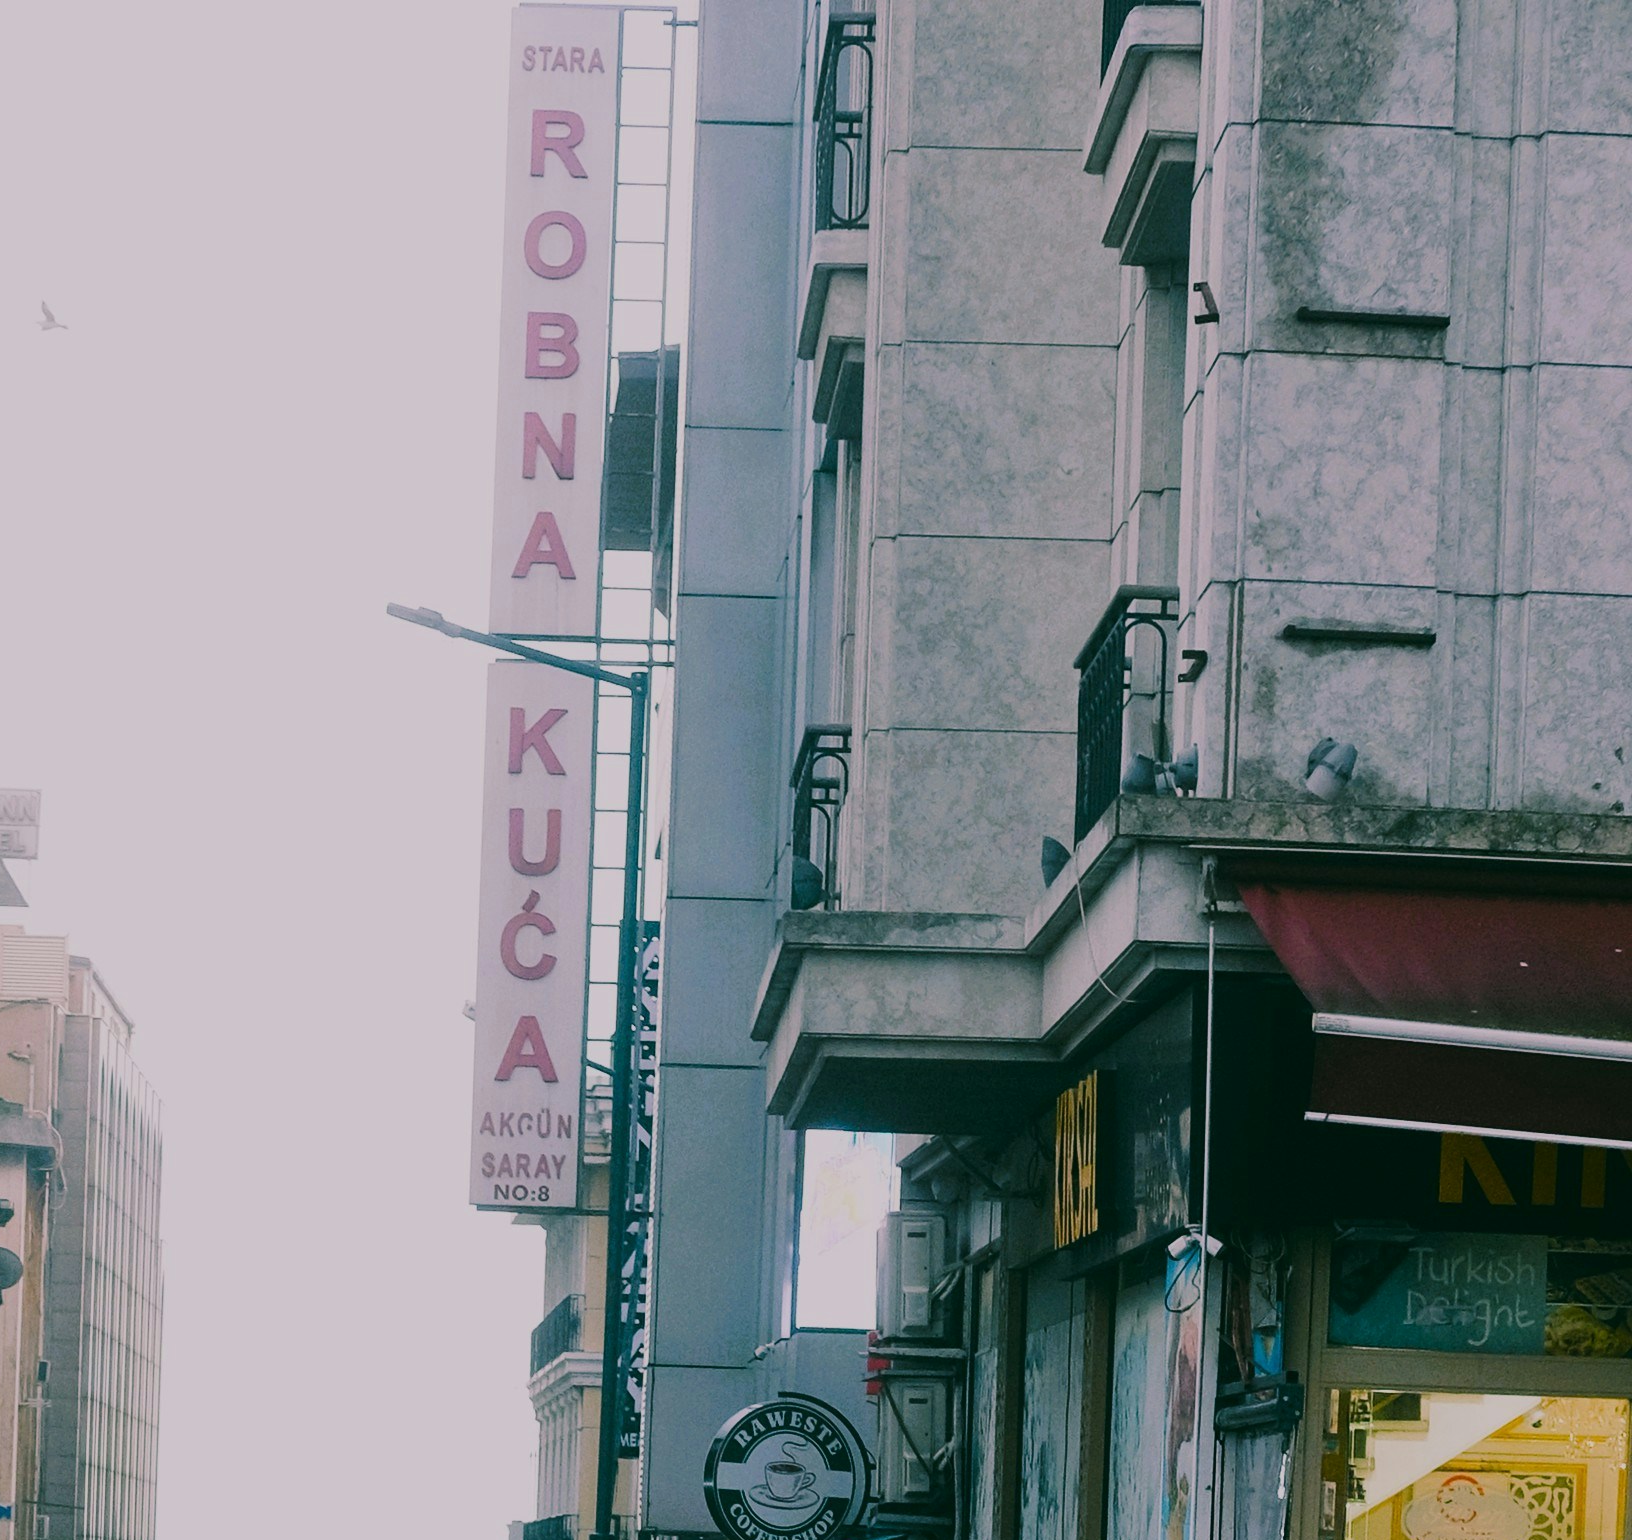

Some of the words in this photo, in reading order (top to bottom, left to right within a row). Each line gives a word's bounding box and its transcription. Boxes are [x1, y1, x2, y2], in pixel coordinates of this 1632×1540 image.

[521, 45, 606, 74] STARA
[511, 107, 589, 581] ROBNA
[493, 706, 569, 1084] KUĆA
[481, 1151, 567, 1180] SARAY
[493, 1183, 550, 1202] NO:8
[1408, 1246, 1536, 1288] Turkish
[733, 1410, 844, 1456] RAWESTE
